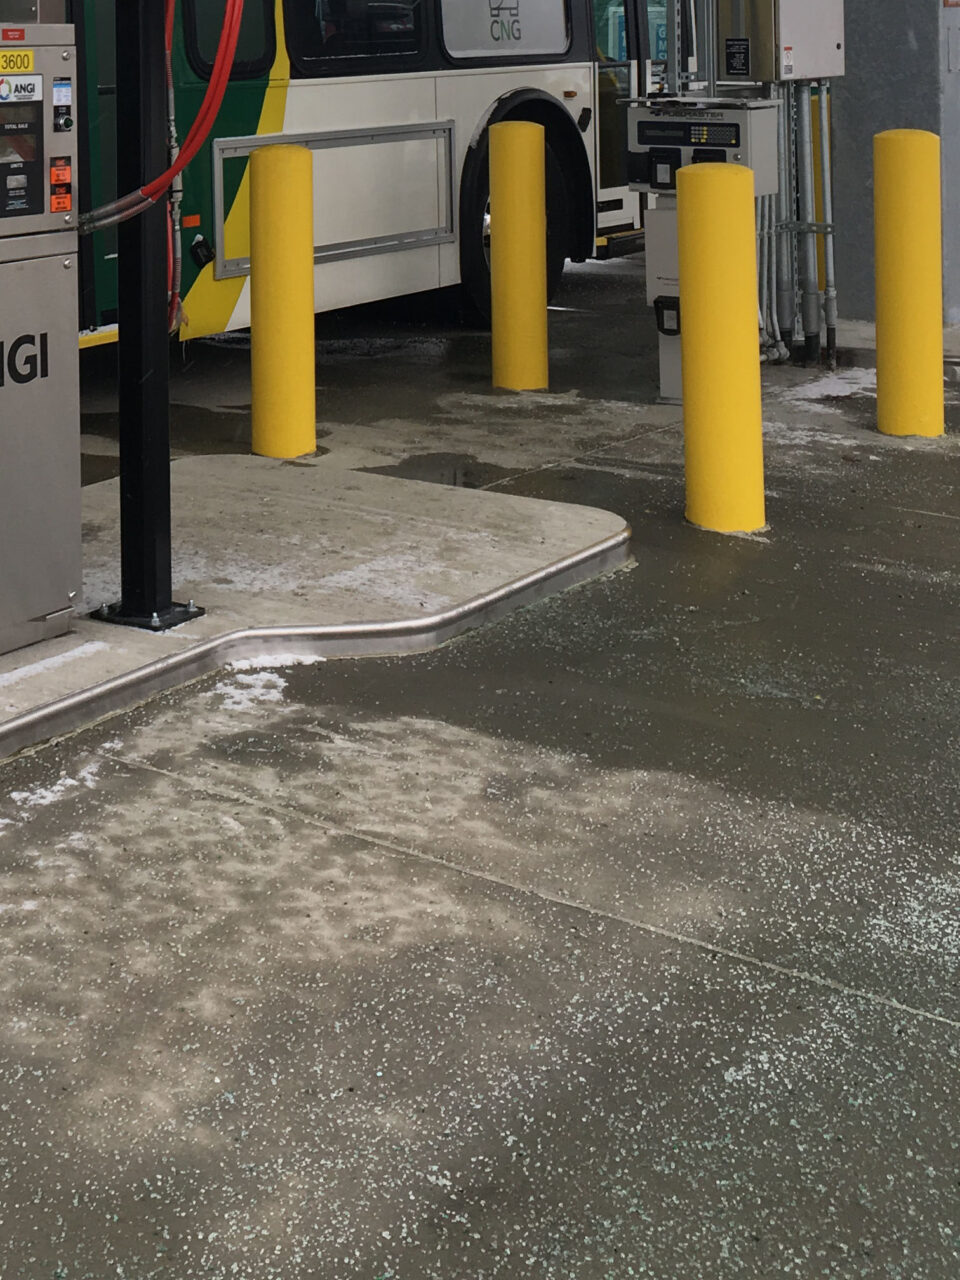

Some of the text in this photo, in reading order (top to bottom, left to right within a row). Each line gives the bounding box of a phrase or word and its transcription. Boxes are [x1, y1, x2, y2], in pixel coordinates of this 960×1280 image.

[490, 19, 521, 41] CNG
[1, 54, 30, 69] 3600
[14, 83, 35, 94] ANGI
